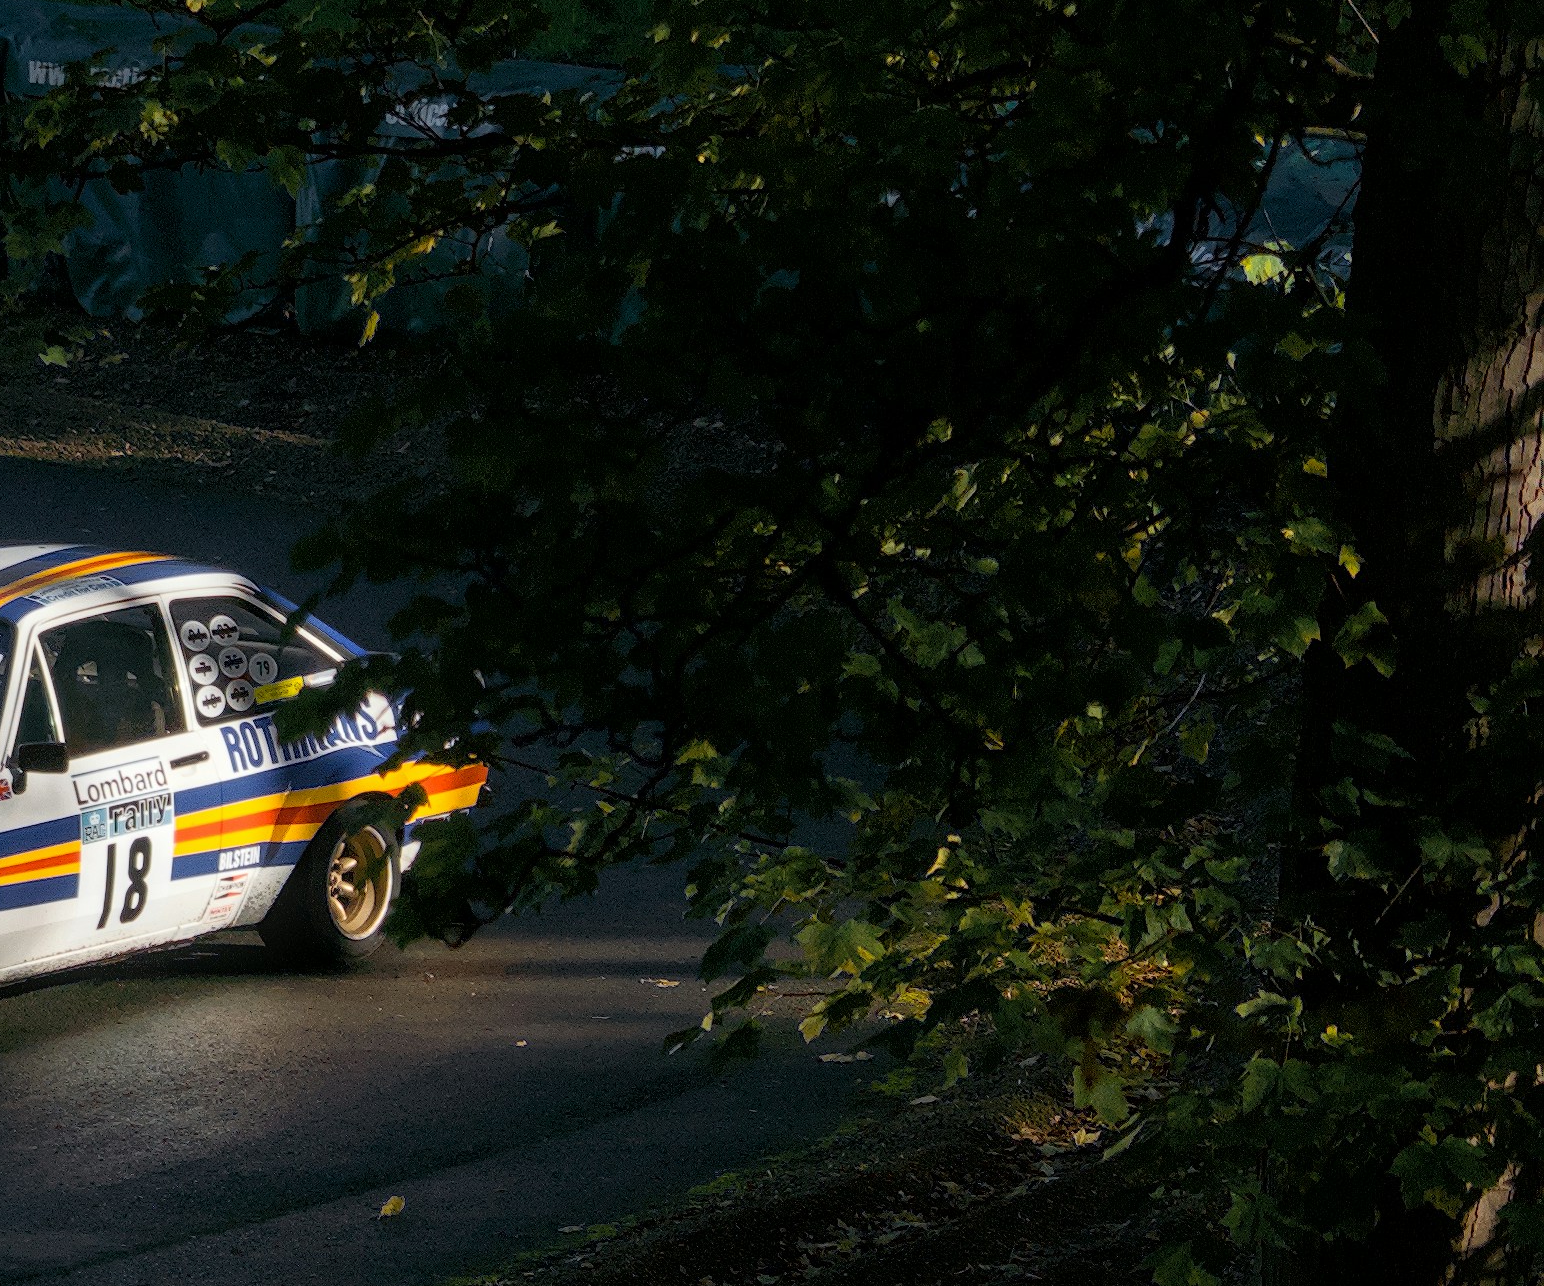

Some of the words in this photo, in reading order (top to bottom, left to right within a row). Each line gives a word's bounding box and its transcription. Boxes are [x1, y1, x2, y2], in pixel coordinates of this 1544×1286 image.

[256, 661, 269, 677] 79
[72, 761, 168, 806] Lombard
[84, 823, 107, 842] RAC
[112, 795, 170, 835] rally
[218, 846, 261, 871] BILSTEIN
[97, 836, 153, 931] 18
